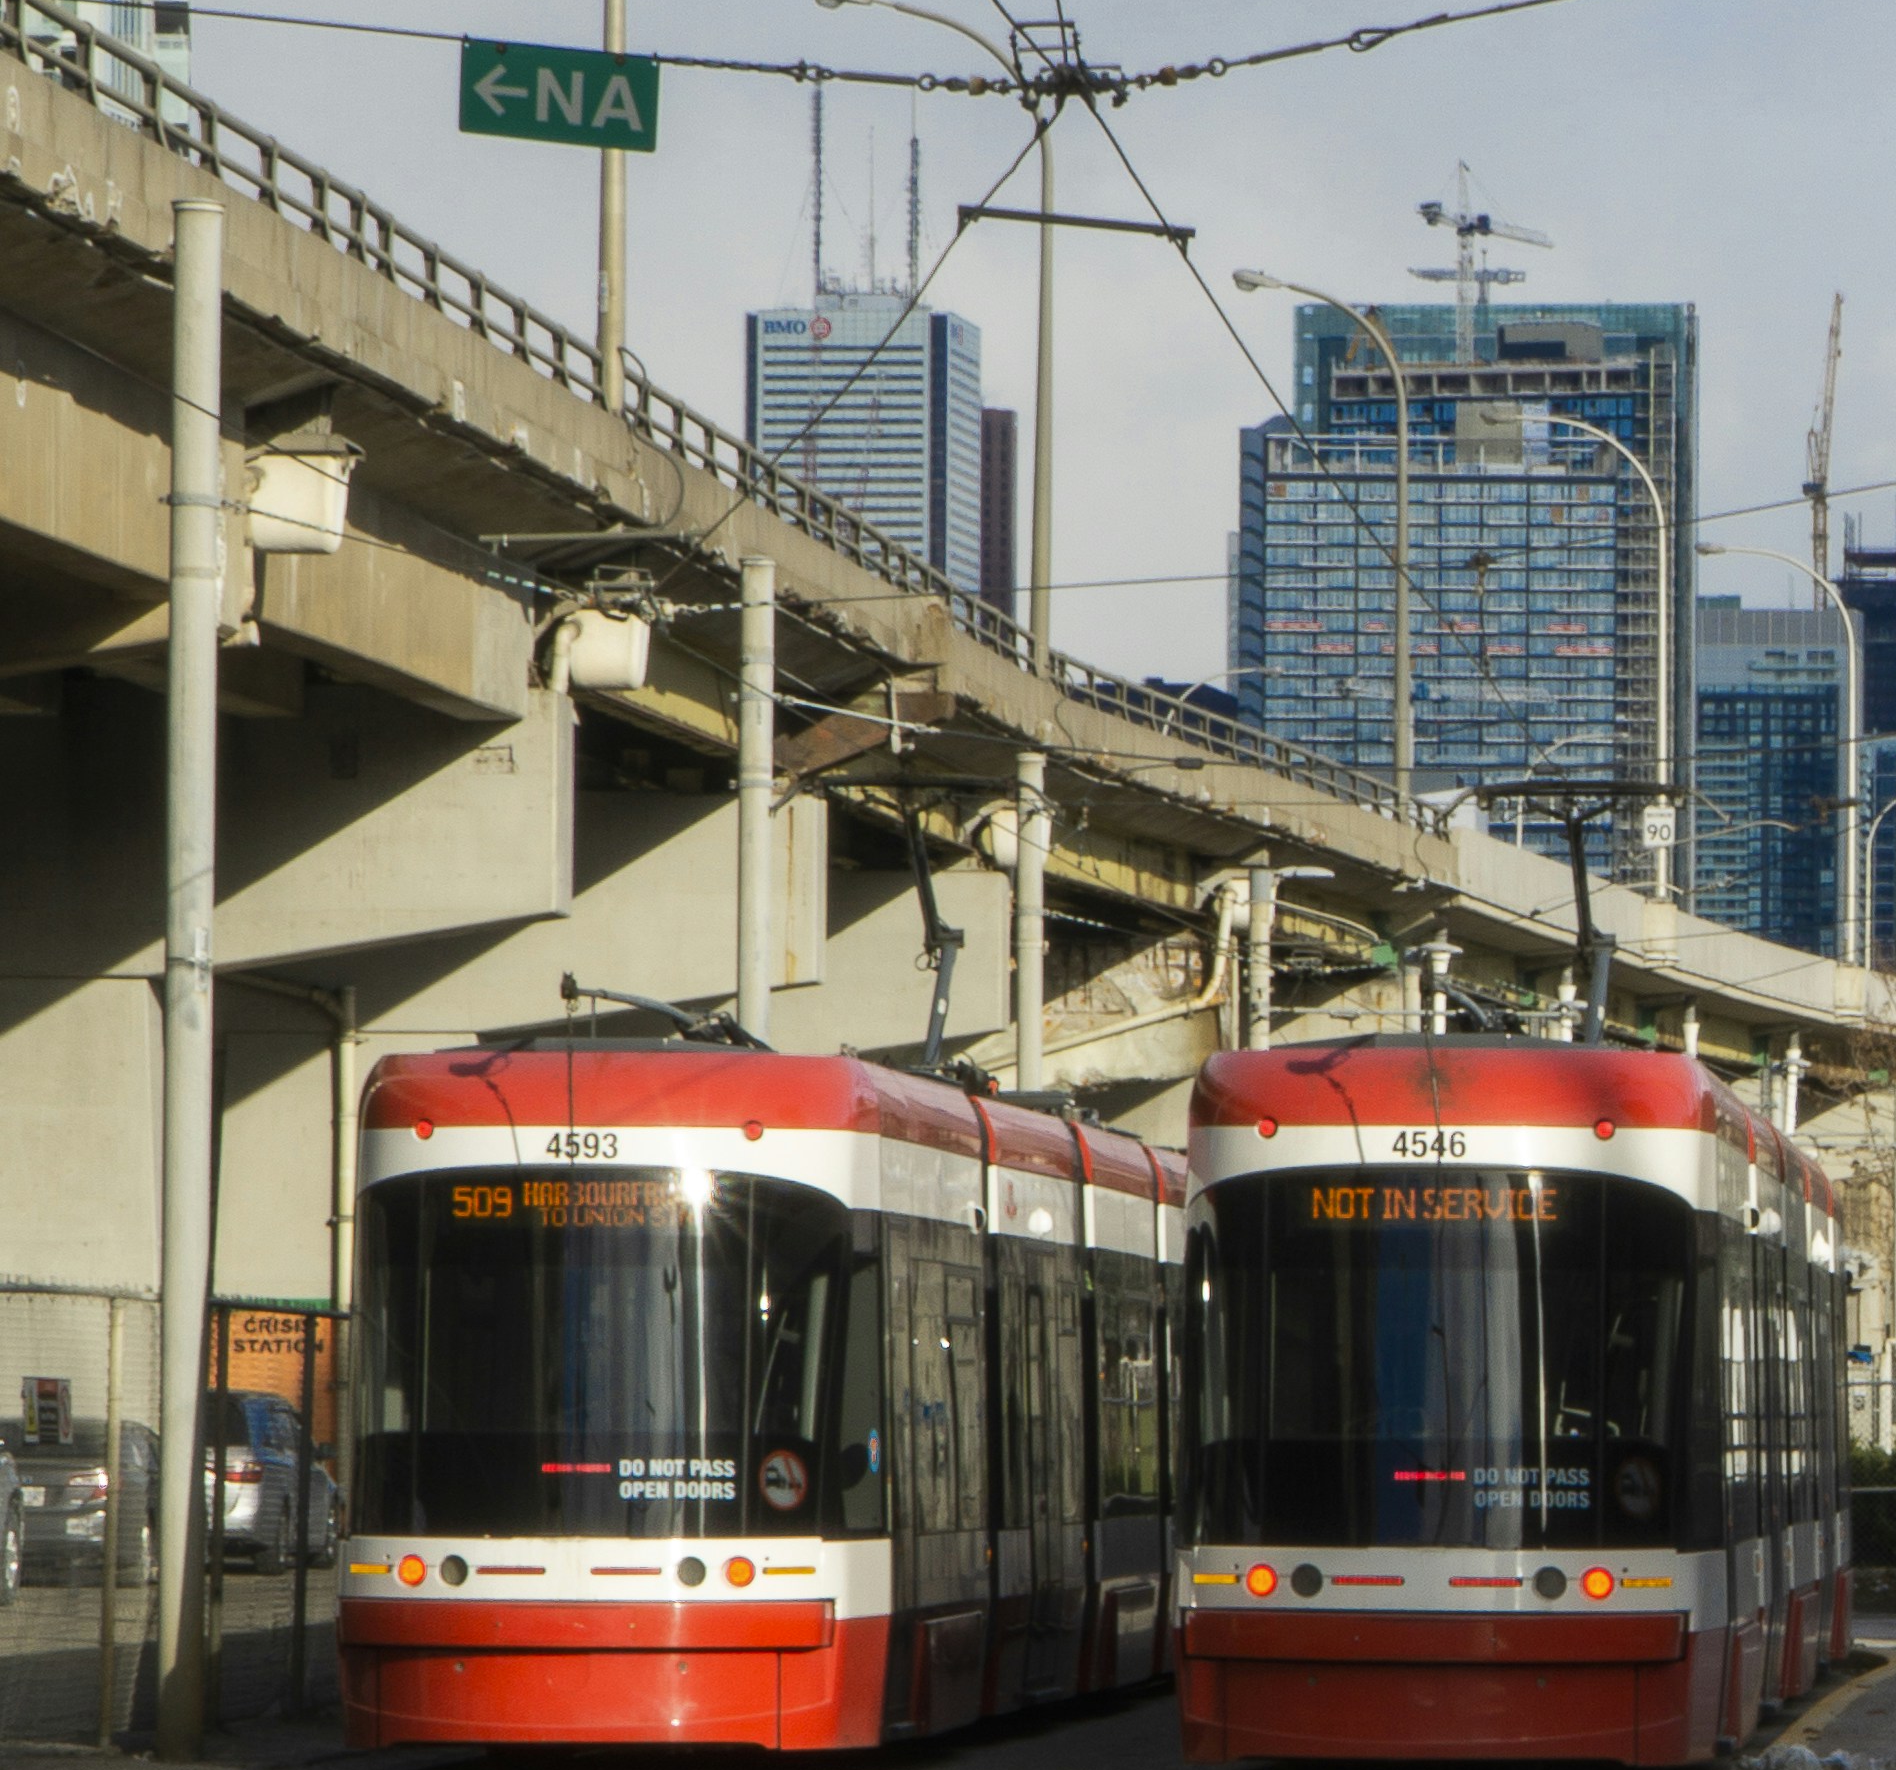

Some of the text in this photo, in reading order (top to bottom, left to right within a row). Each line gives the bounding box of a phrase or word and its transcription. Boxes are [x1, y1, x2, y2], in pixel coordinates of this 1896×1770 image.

[535, 67, 643, 132] NA
[763, 320, 806, 334] BMO
[1647, 824, 1671, 840] 90
[546, 1133, 618, 1158] 4593
[1392, 1130, 1466, 1158] 4546
[453, 1186, 512, 1218] 509
[1312, 1187, 1558, 1220] NOT IN SERVICE
[541, 1207, 568, 1227] TO
[574, 1206, 645, 1228] UNION
[244, 1317, 318, 1333] CRISI
[619, 1459, 736, 1478] DO NOT PASS
[1473, 1468, 1590, 1485] DO NOT PASS
[619, 1481, 736, 1500] OPEN DOORS
[1474, 1490, 1590, 1508] OPEN DOORS
